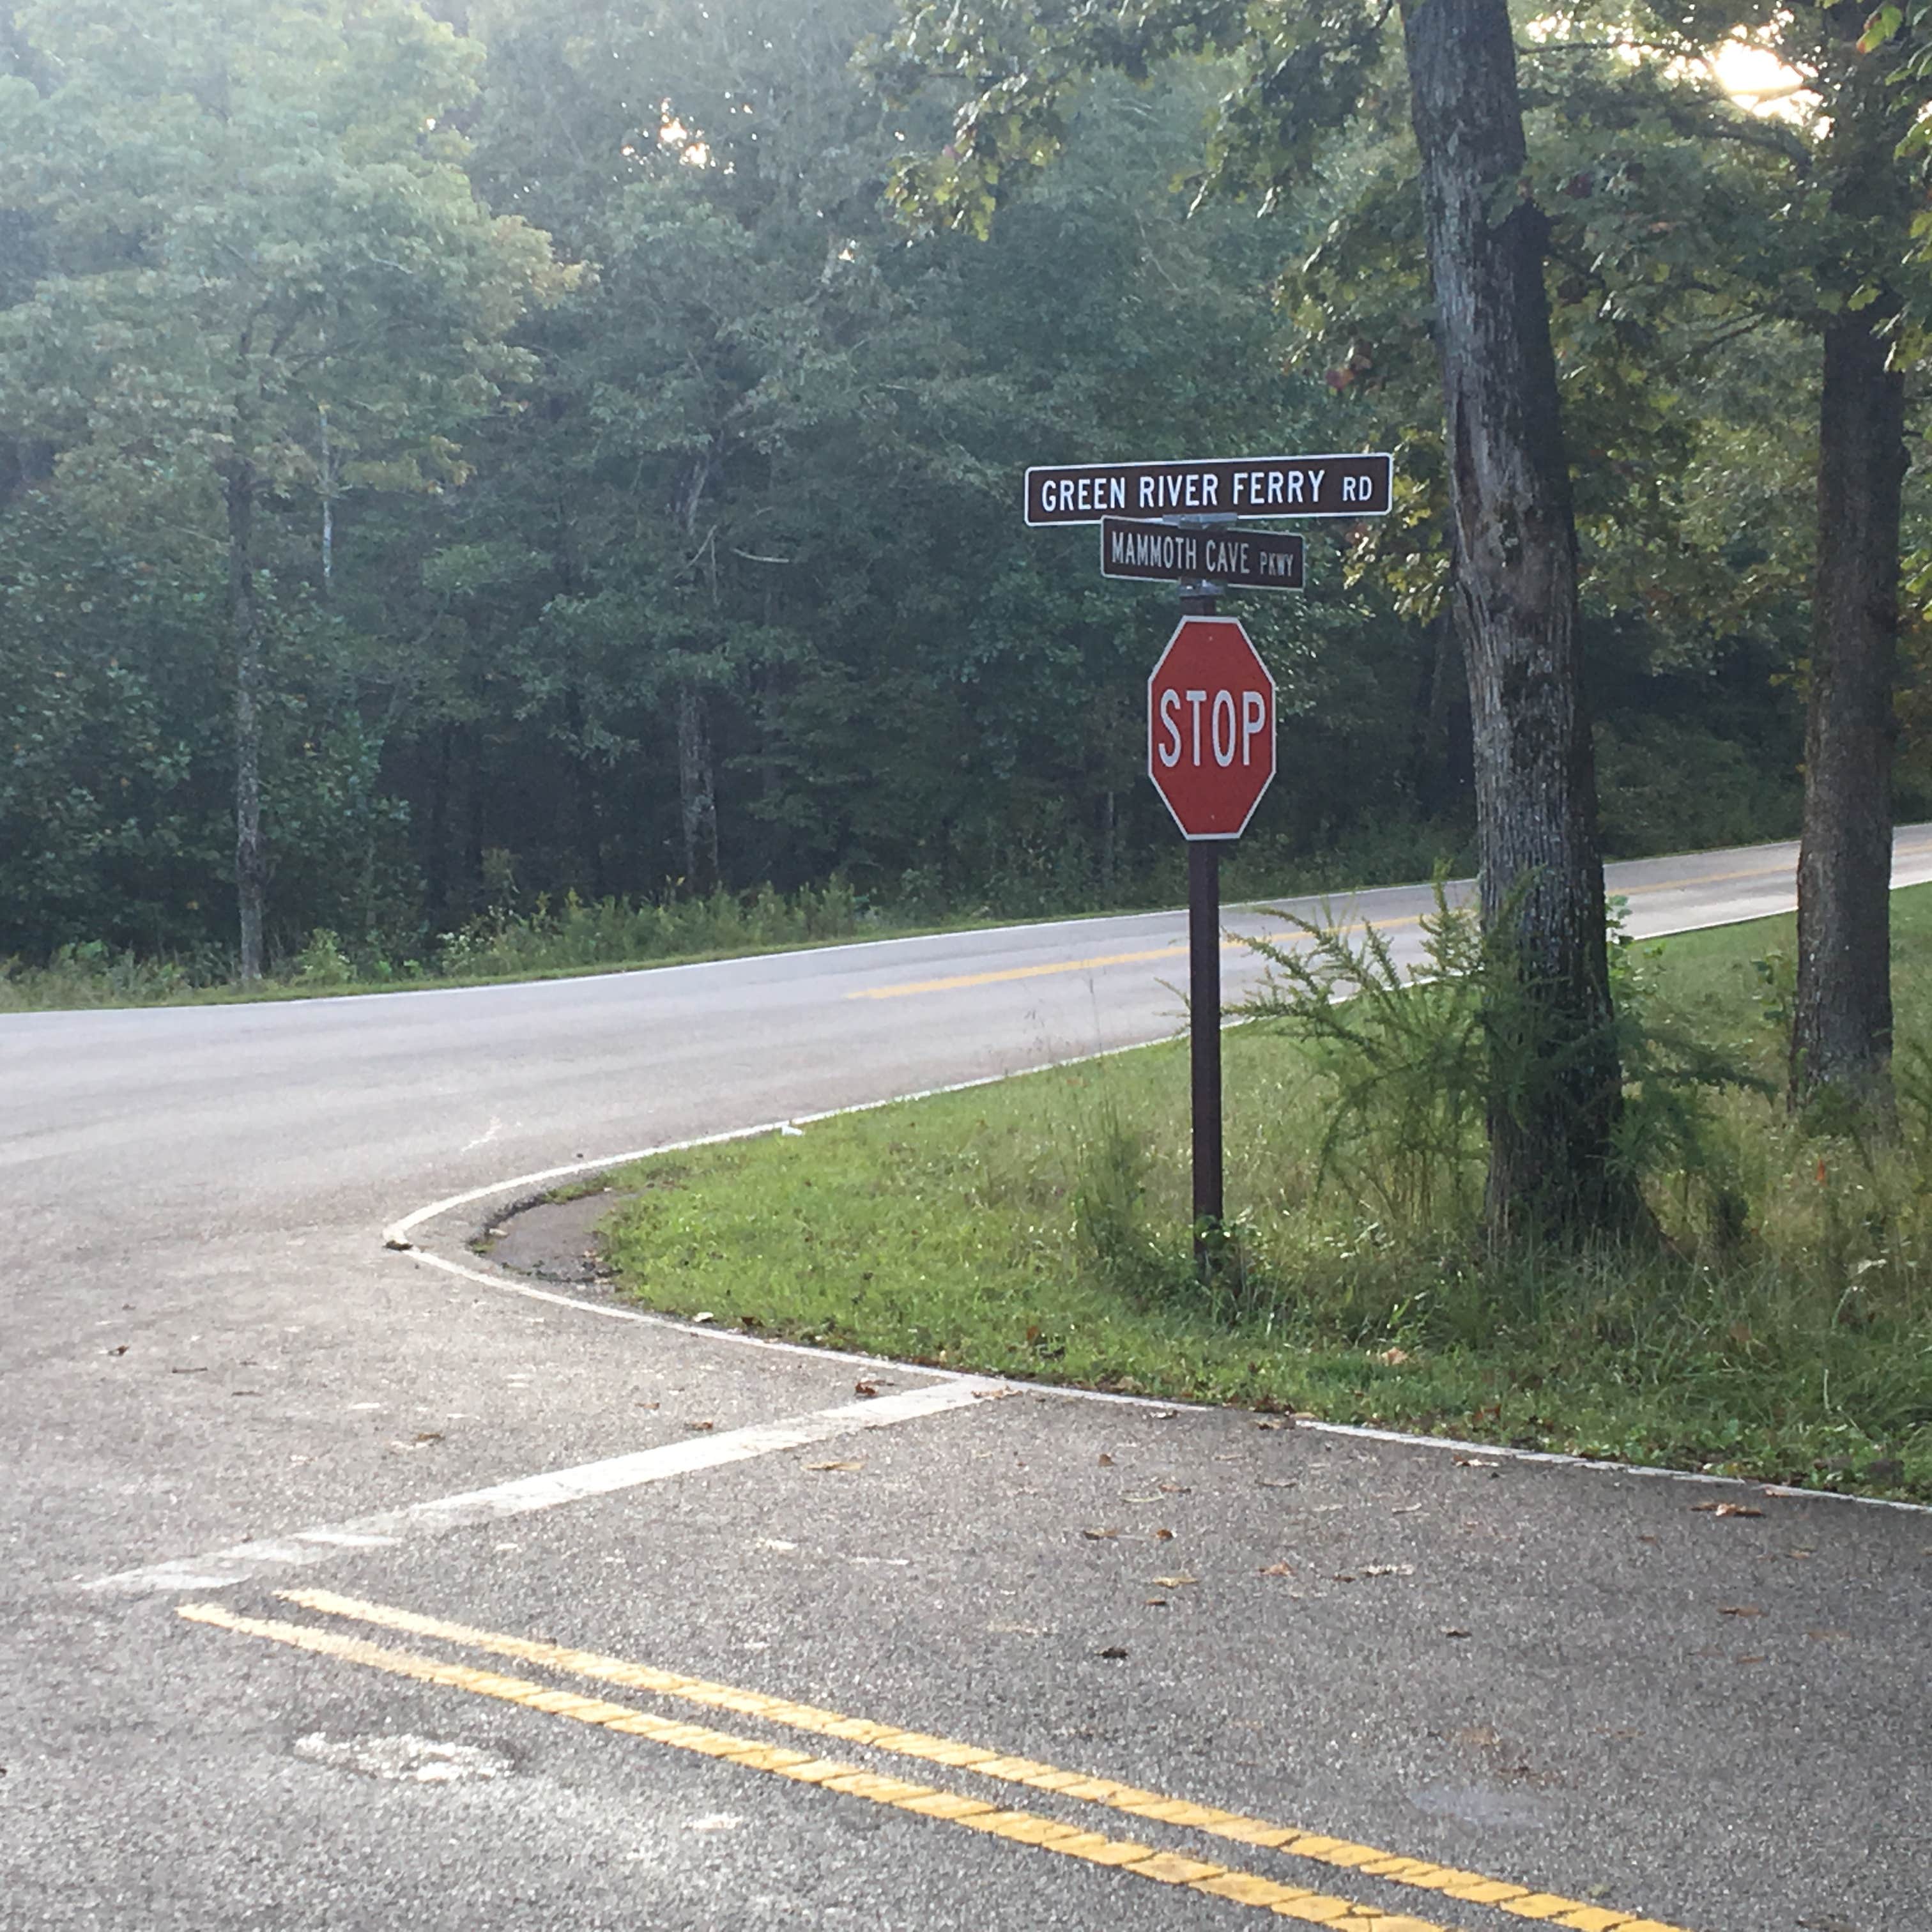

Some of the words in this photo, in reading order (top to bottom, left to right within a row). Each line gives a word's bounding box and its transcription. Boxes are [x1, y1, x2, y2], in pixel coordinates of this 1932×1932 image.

[1041, 477, 1125, 512] GREEN
[1139, 473, 1218, 508] RIVER
[1232, 470, 1325, 505] FERRY
[1342, 476, 1372, 502] RD
[1112, 532, 1197, 570] MAMMOTH
[1206, 540, 1250, 574] CAVE
[1260, 551, 1294, 577] PKWY
[1158, 689, 1266, 767] STOP
